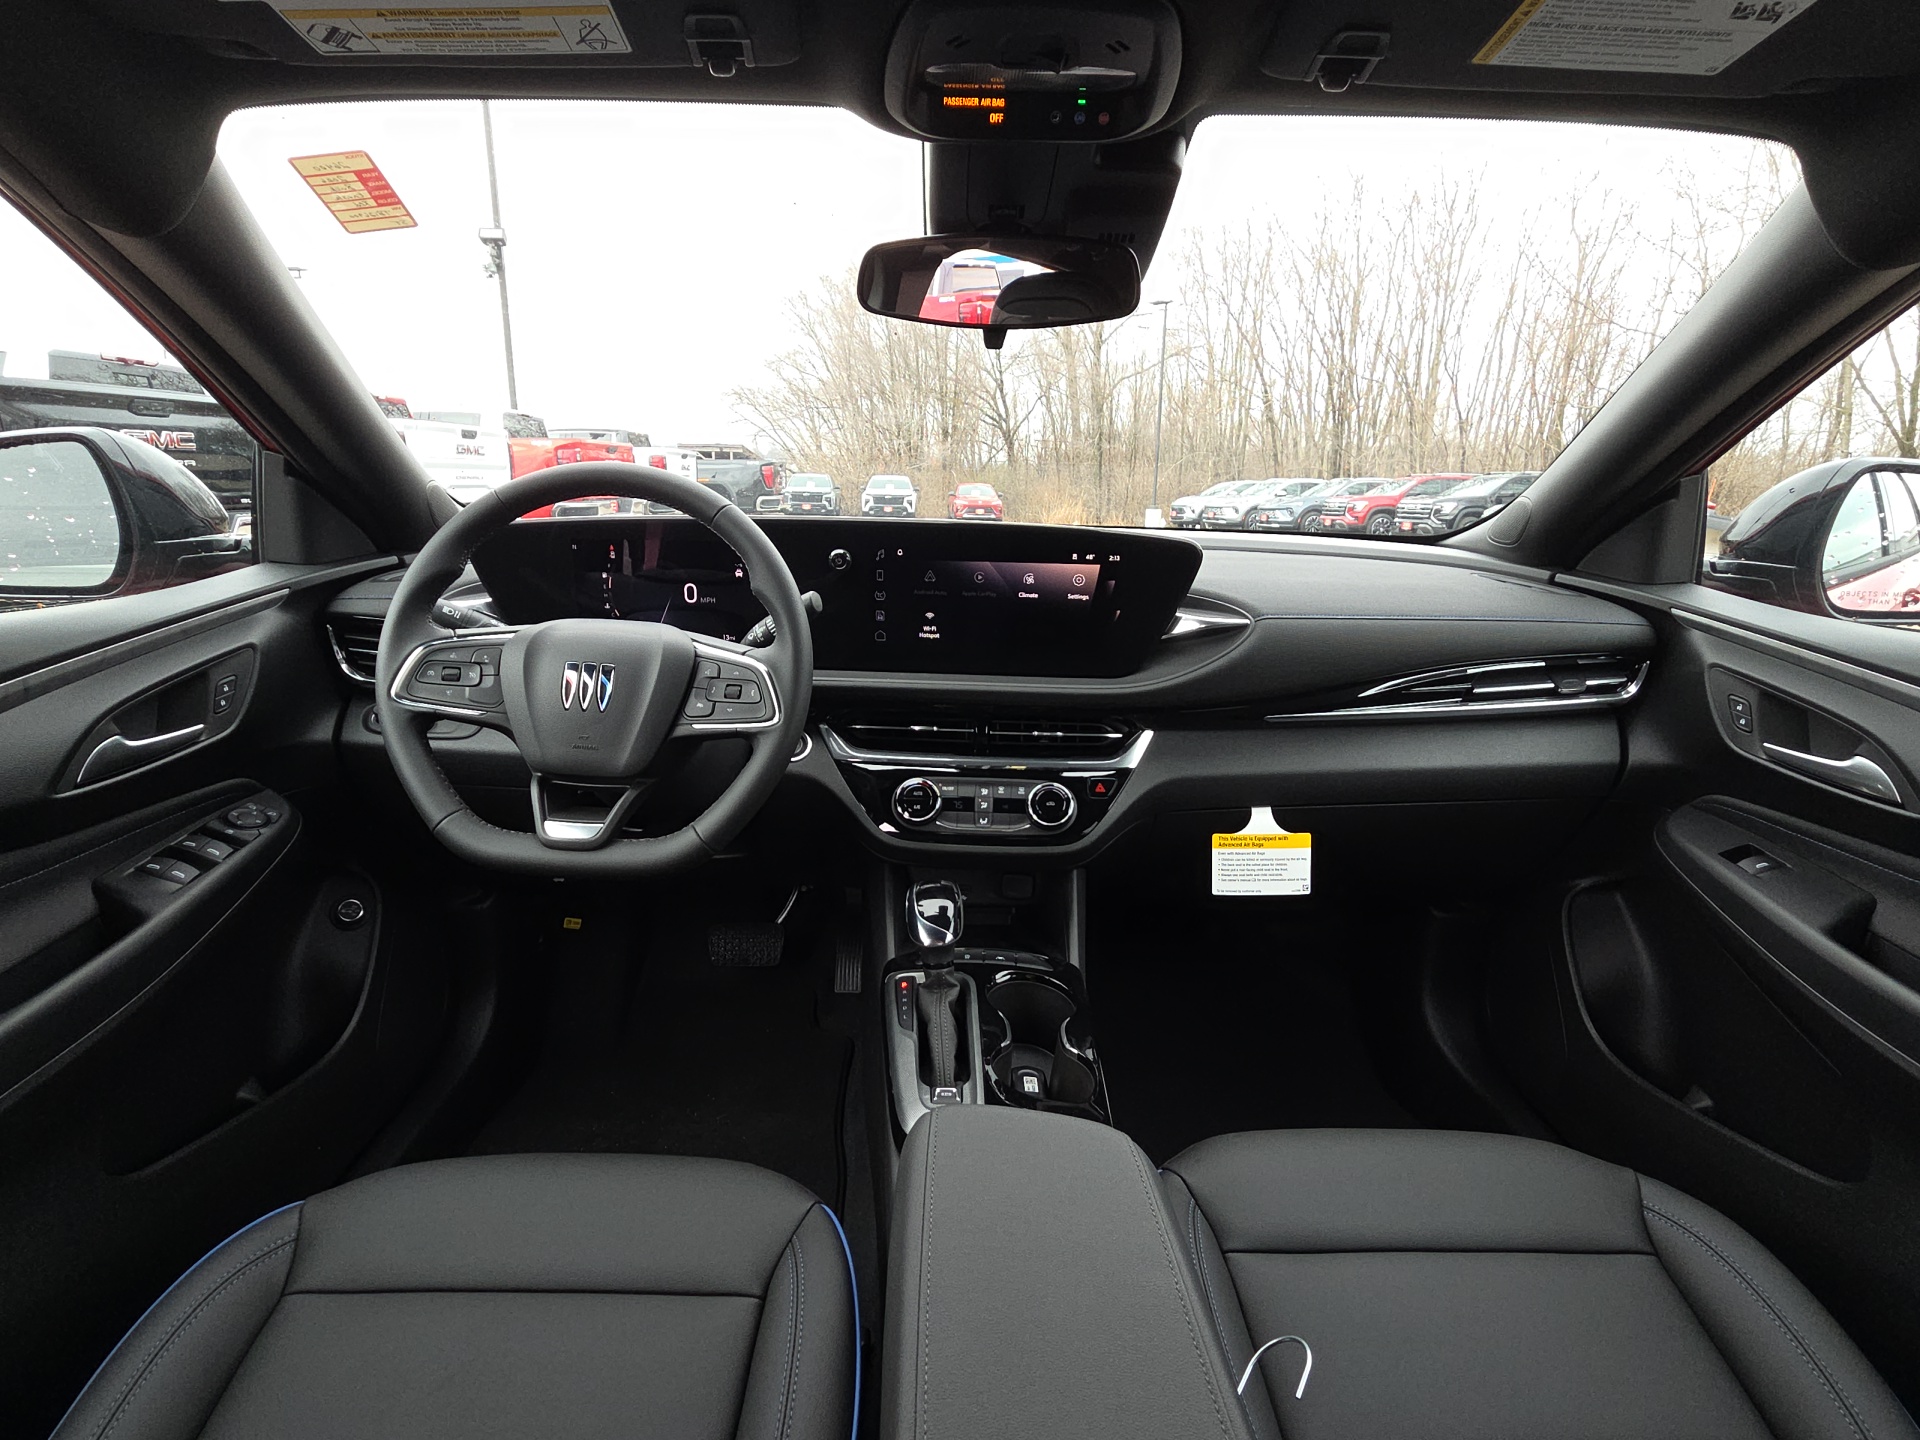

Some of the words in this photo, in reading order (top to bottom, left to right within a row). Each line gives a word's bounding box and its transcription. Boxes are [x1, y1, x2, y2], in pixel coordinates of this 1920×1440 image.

[944, 96, 979, 106] PASSENGER
[980, 98, 992, 106] AIR
[992, 98, 1005, 107] BAG
[990, 113, 1004, 123] OFF
[456, 445, 485, 456] GMC
[684, 583, 698, 603] 0
